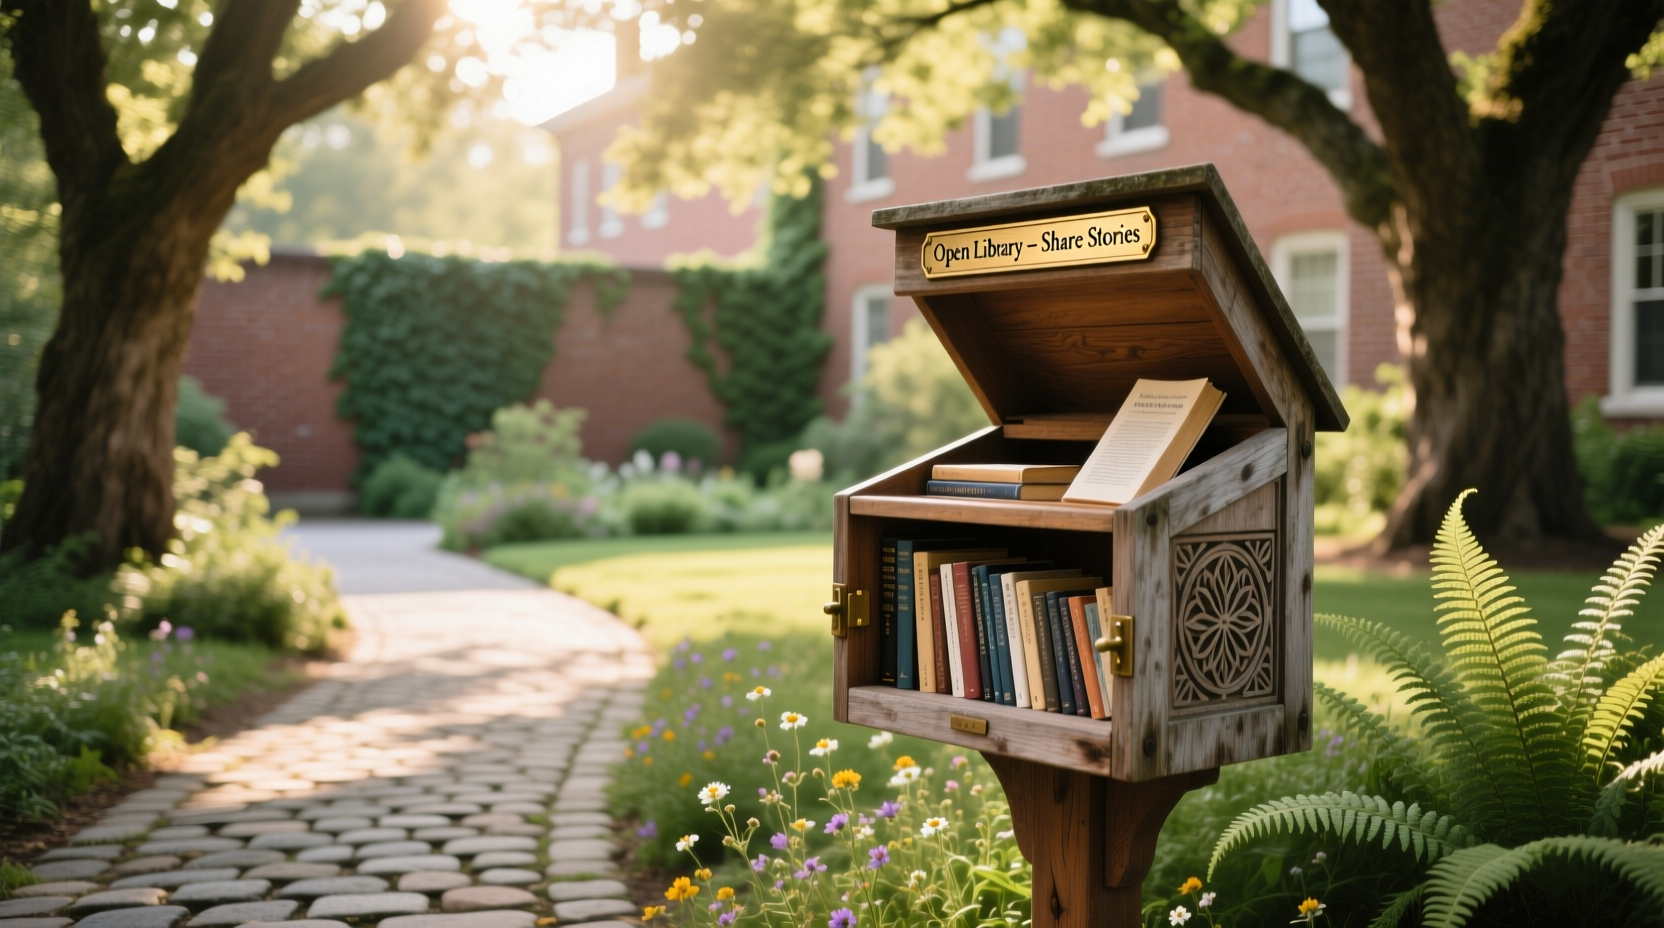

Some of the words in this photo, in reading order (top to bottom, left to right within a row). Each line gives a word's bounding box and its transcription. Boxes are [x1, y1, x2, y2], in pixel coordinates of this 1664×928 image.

[933, 243, 970, 267] Open
[973, 238, 1023, 262] Library
[1041, 230, 1083, 252] Share
[1088, 224, 1140, 247] Stories
